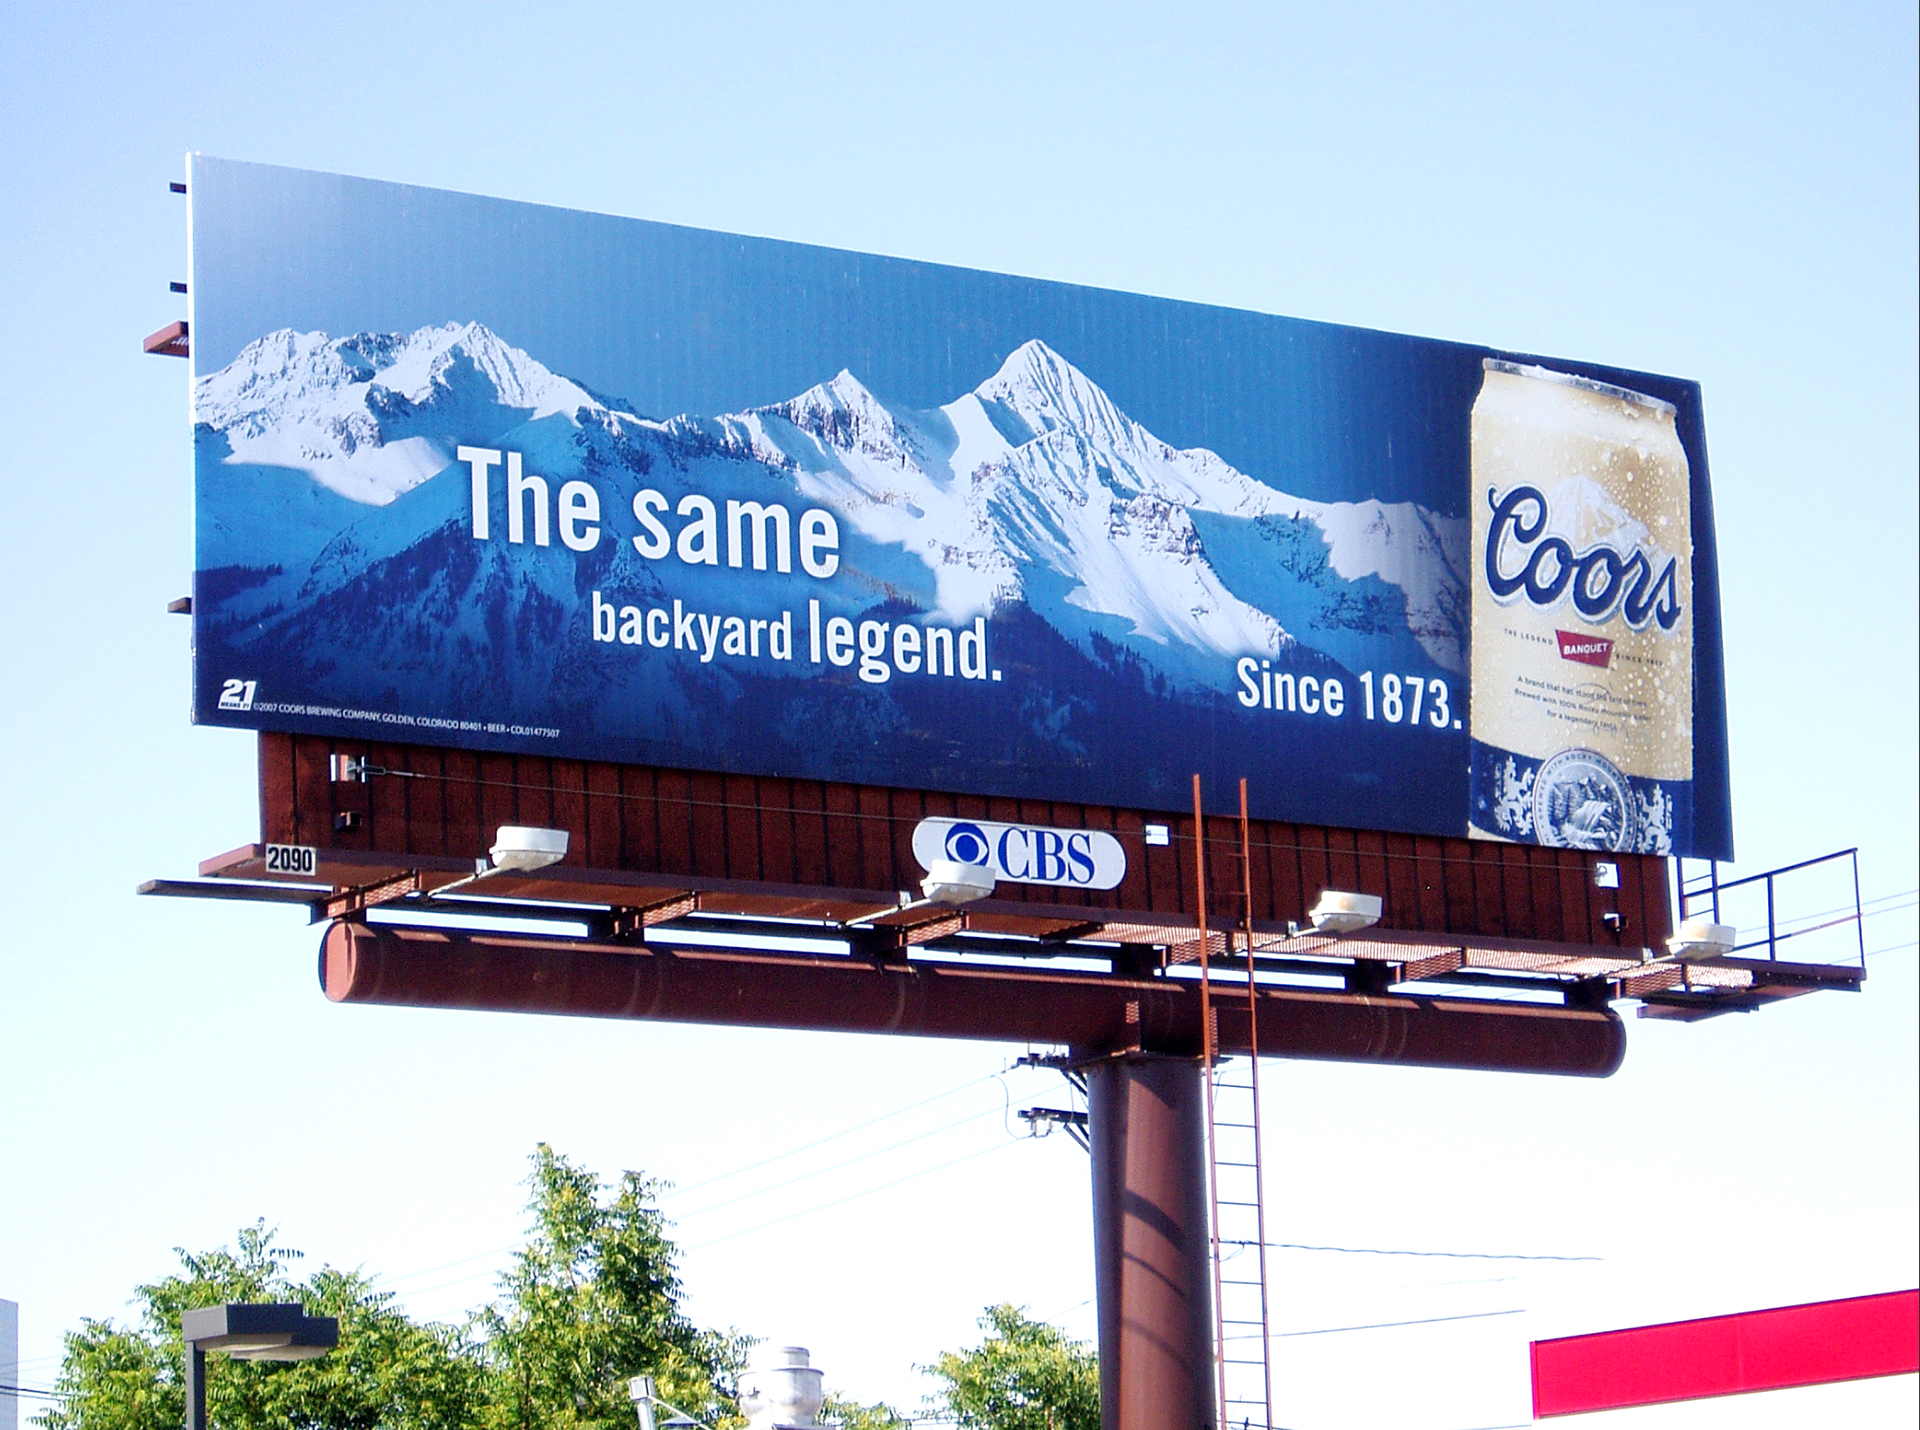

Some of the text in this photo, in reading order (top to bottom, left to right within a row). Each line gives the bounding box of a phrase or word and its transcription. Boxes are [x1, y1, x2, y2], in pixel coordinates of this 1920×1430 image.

[457, 445, 840, 578] The same
[1485, 485, 1683, 631] Coors
[592, 591, 1003, 684] backyard legend.
[1504, 628, 1553, 646] THE LEGEND
[1563, 642, 1608, 655] BANQUET
[219, 678, 257, 702] 21
[1237, 657, 1464, 729] Since 1873.
[1514, 688, 1540, 701] Brewed
[1525, 677, 1545, 688] brand
[279, 704, 306, 715] COORS
[306, 706, 342, 718] BREWING
[342, 709, 381, 722] COMPANY,
[382, 713, 416, 726] GOLDEN,
[416, 717, 459, 730] COLORADO
[460, 720, 482, 731] 80401
[487, 723, 506, 734] BEER
[268, 846, 313, 873] 2090
[999, 826, 1096, 883] CBS
